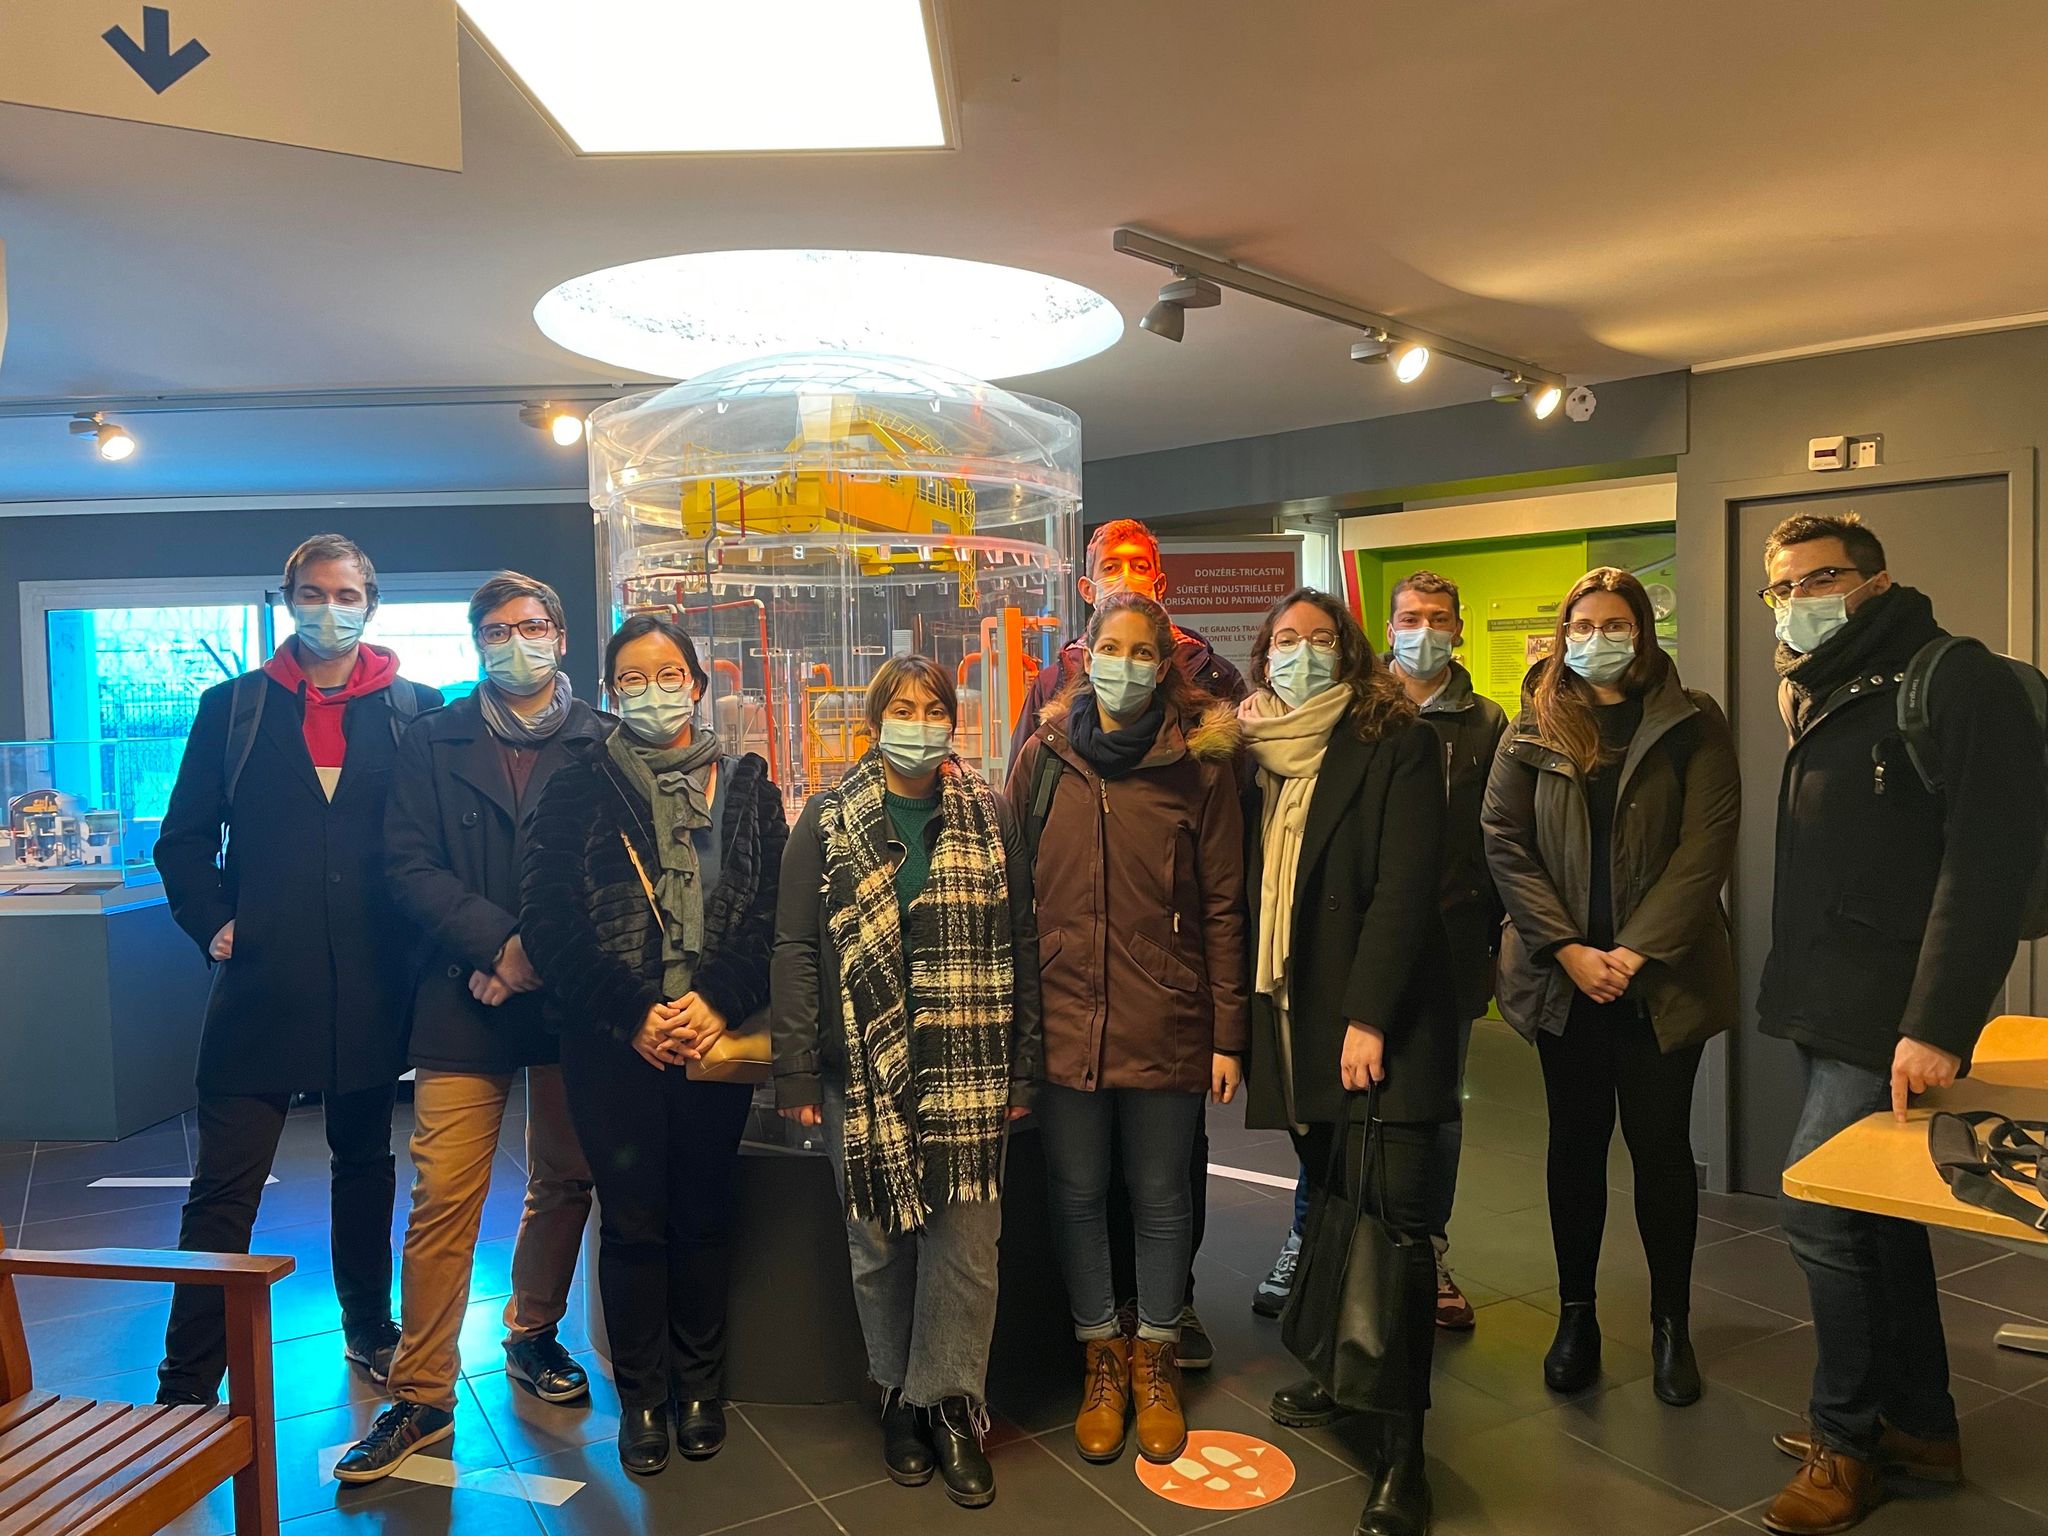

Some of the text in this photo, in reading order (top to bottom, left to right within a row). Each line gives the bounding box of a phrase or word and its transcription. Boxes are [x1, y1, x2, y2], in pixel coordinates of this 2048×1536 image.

[1195, 567, 1285, 577] DONZÈRE-TRICASTIN
[1176, 583, 1285, 594] SÛRETÉ INDUSTRIELLE ET
[1215, 596, 1229, 605] DU
[1210, 625, 1240, 633] GRANDS
[1234, 634, 1246, 642] LES
